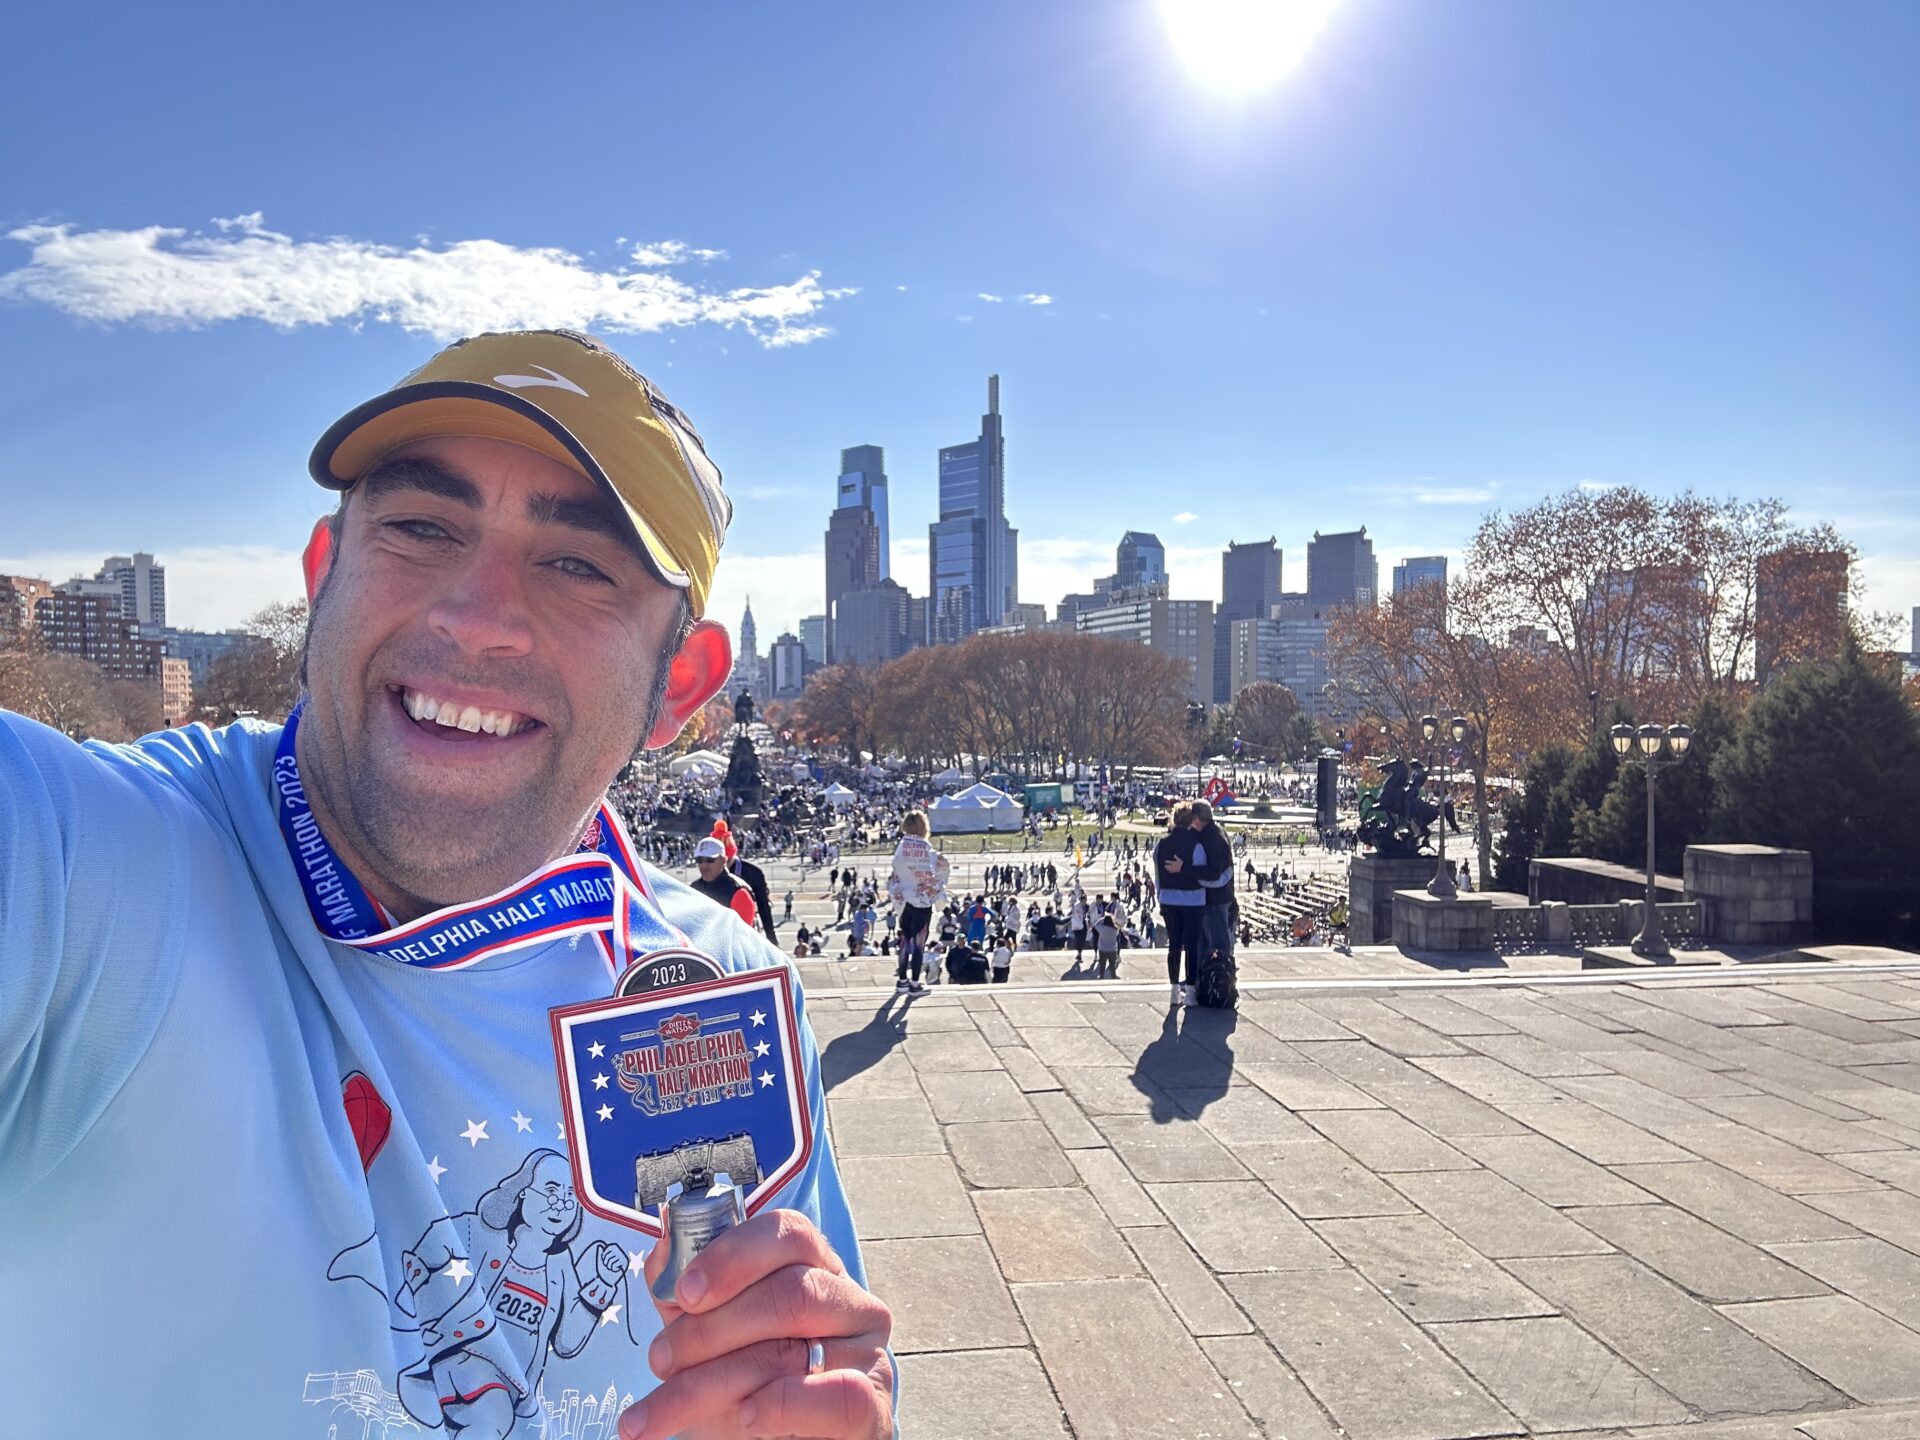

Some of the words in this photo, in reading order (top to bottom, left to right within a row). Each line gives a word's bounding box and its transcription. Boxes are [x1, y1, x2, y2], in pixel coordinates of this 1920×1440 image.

[276, 755, 308, 808] 2023
[291, 811, 357, 925] MARATHON
[489, 894, 549, 930] HALF
[652, 963, 687, 987] 2023
[665, 1025, 694, 1035] WATSON
[668, 1021, 687, 1029] DIETZ
[623, 1031, 746, 1073] PHILADELPHIA
[657, 1070, 686, 1097] HALF
[688, 1056, 750, 1091] MARATHON
[661, 1096, 682, 1111] 26.2
[701, 1089, 719, 1103] 13.1
[740, 1083, 752, 1095] 8K
[496, 1293, 542, 1325] 2023
